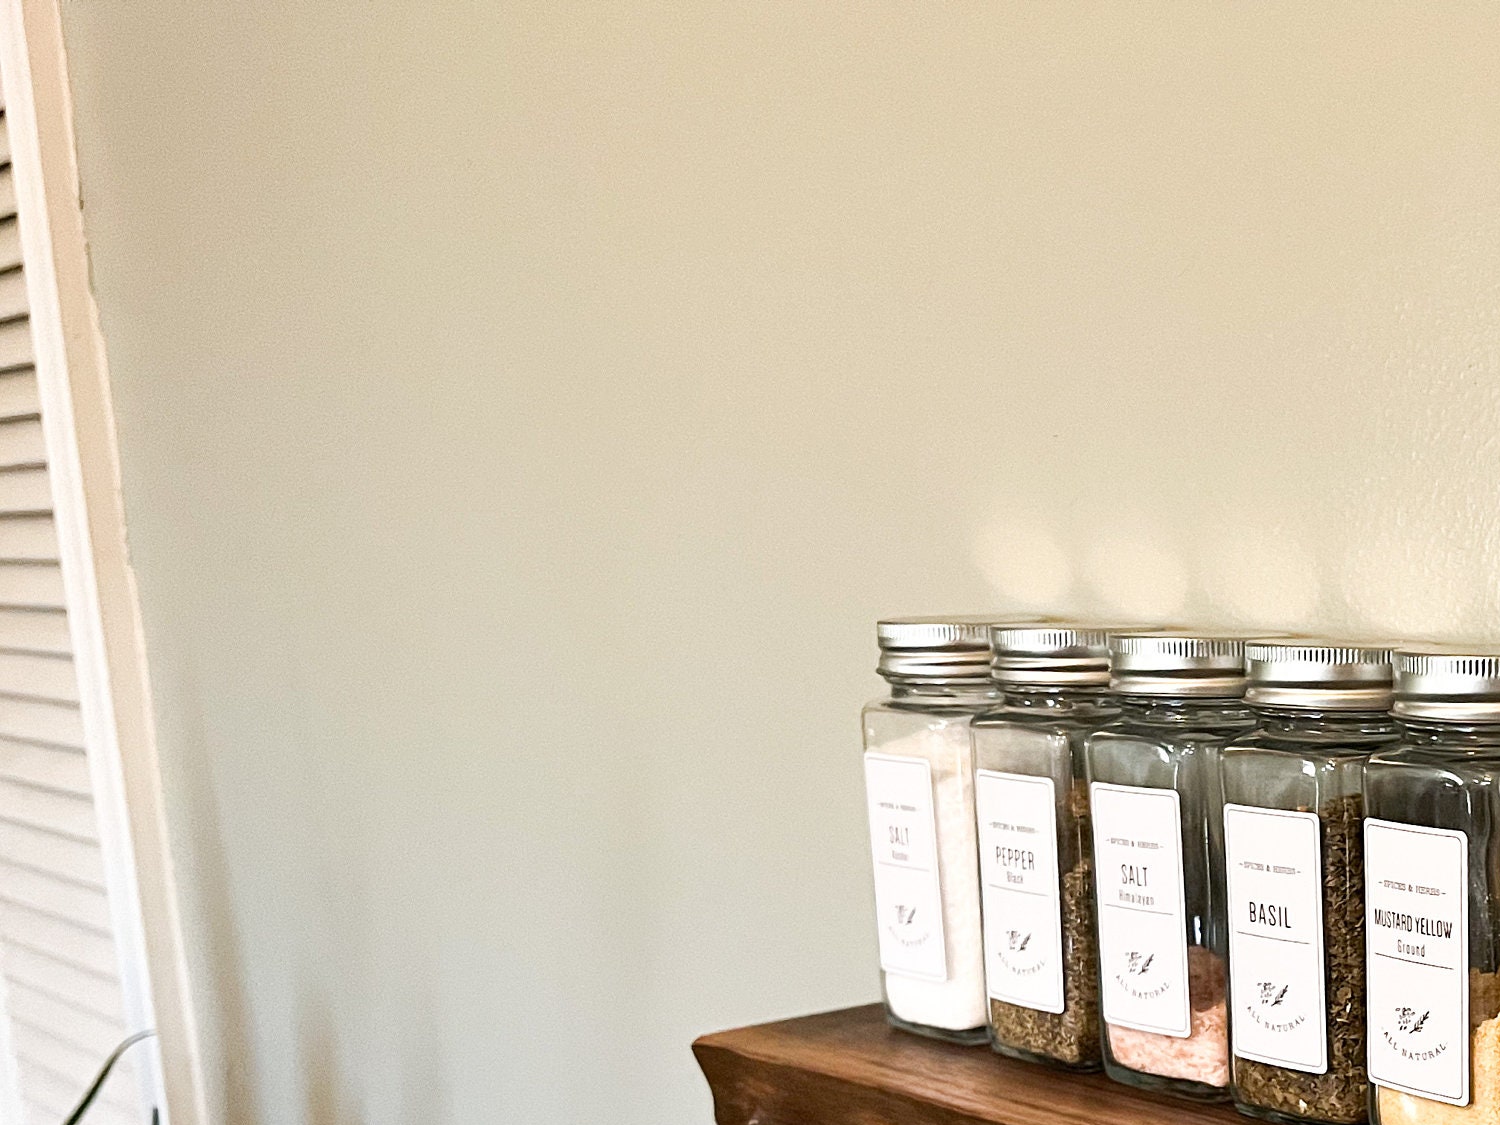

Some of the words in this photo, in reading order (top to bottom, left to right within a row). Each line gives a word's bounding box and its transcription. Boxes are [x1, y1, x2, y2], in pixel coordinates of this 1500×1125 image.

[889, 825, 909, 846] SALT
[996, 846, 1034, 871] PEPPER
[1121, 864, 1148, 886] SALT
[1249, 901, 1292, 928] BASIL
[1374, 908, 1413, 933] MUSTARD
[1415, 917, 1453, 939] YELLOW
[1397, 939, 1426, 958] Ground
[1132, 982, 1170, 999] NATURAL
[1246, 1006, 1261, 1024] ALL
[1265, 1015, 1305, 1032] NATURAL
[1383, 1031, 1398, 1051] ALL
[1401, 1042, 1446, 1061] NATURAL
